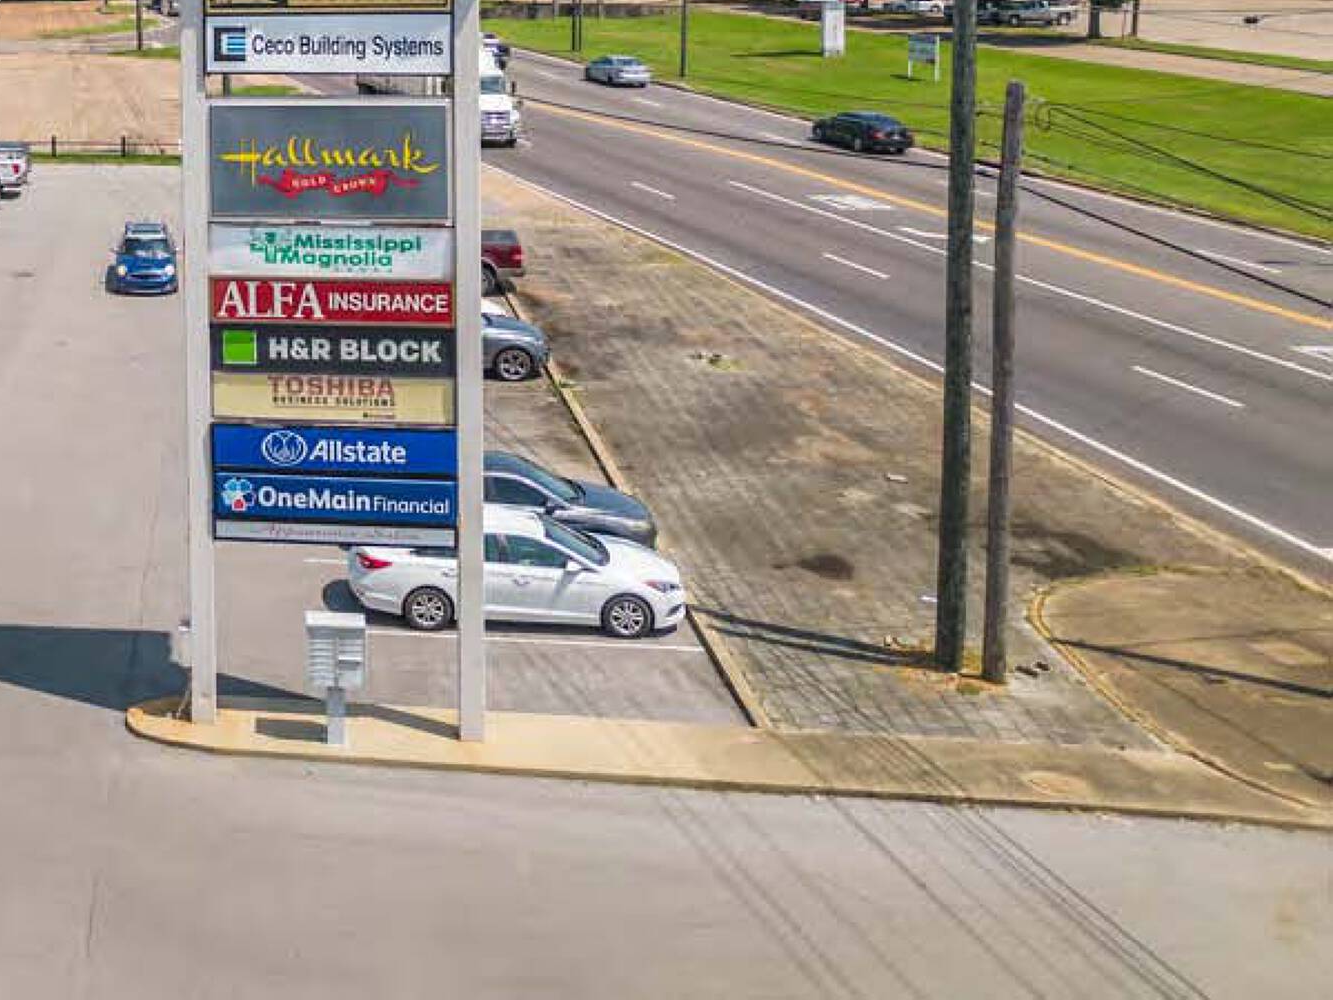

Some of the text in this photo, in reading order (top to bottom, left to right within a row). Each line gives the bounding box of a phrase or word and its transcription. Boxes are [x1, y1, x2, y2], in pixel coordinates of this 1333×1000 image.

[252, 34, 444, 60] Ceco Building Systems
[219, 130, 440, 188] Hallmark
[295, 233, 422, 253] Mississippi
[282, 250, 393, 268] Magnolia
[218, 279, 449, 319] ALFA INSURANCE
[267, 337, 442, 364] H&R BLOCK
[267, 375, 394, 396] TOSHIBA
[309, 439, 407, 464] Allstate
[257, 485, 451, 515] OneMain Financial
